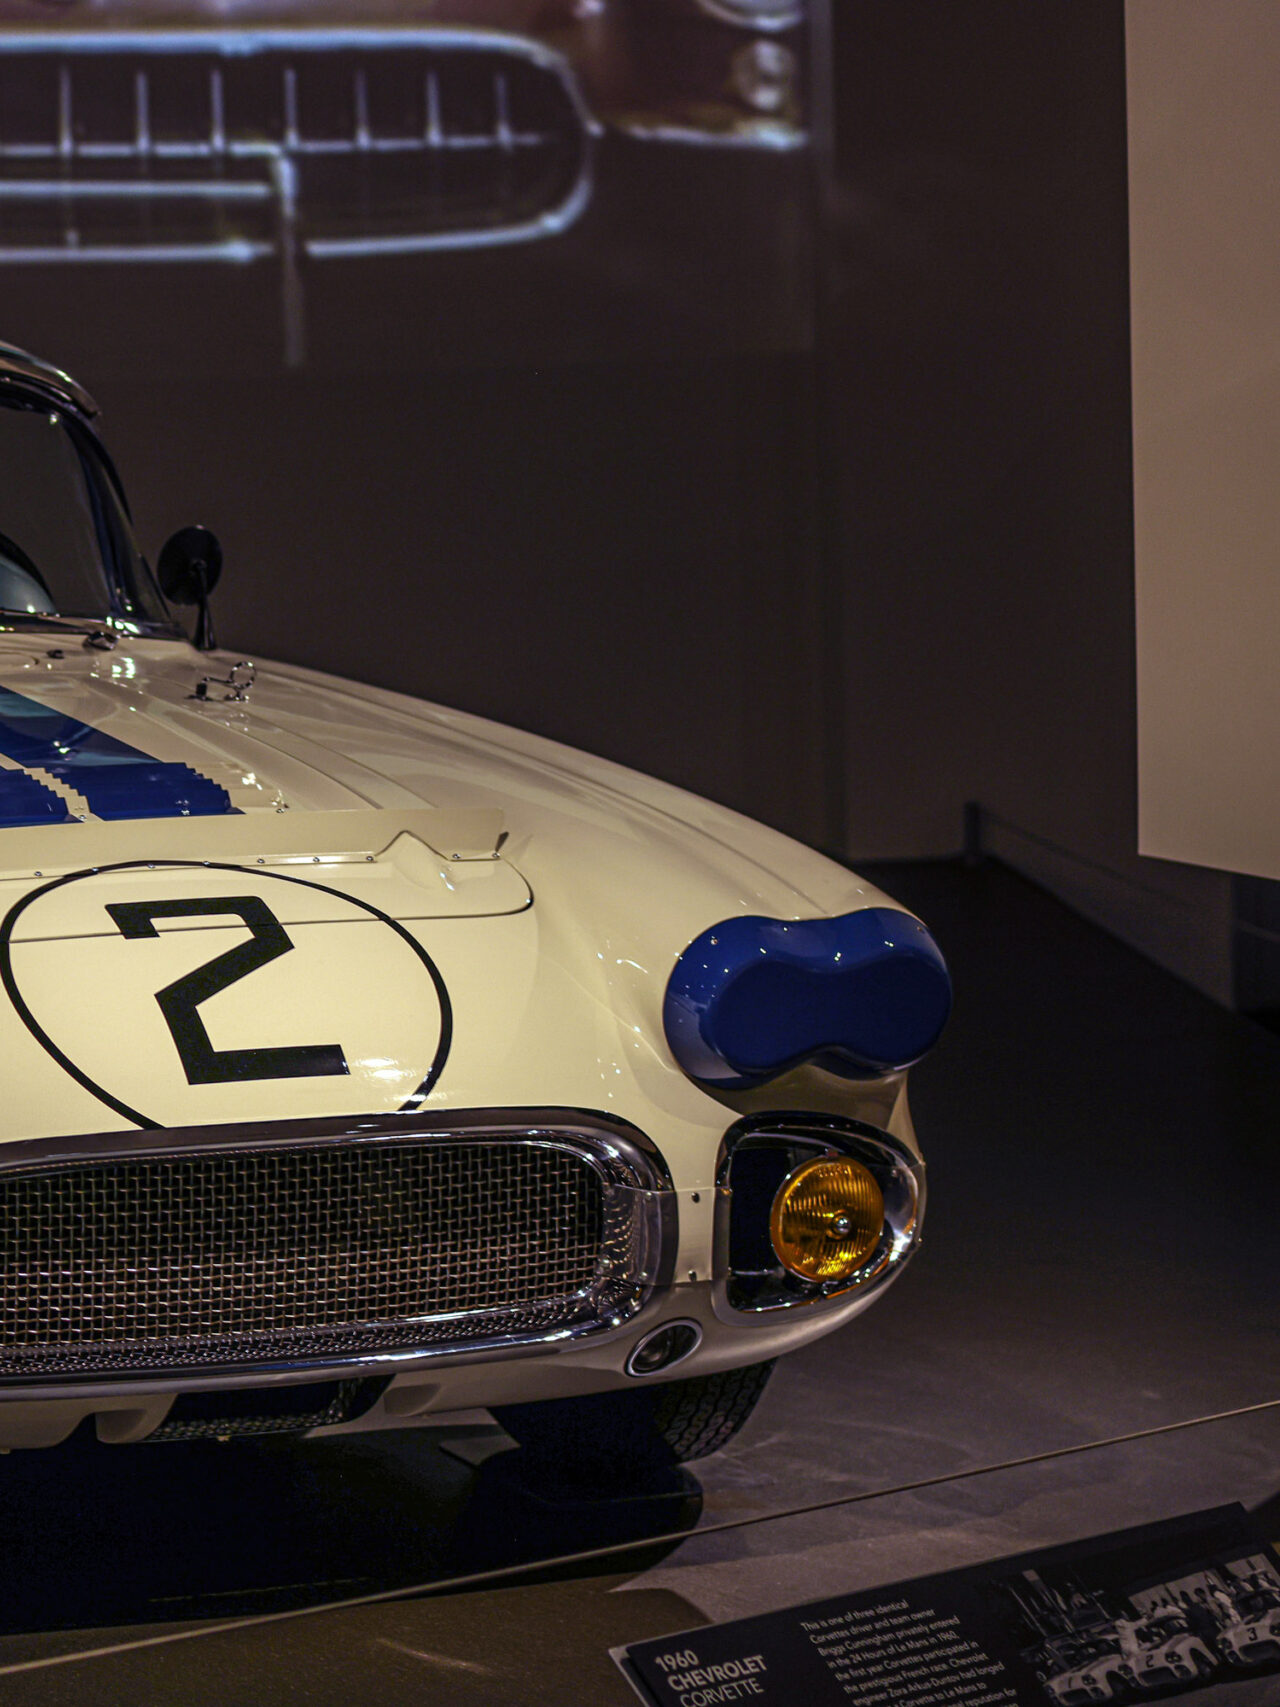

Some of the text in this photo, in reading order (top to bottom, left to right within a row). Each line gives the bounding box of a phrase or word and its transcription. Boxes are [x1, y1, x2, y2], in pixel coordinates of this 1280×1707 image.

[105, 896, 351, 1085] 2
[800, 1622, 820, 1632] This
[827, 1617, 844, 1626] one
[844, 1611, 854, 1622] of
[853, 1610, 875, 1620] three
[874, 1598, 909, 1614] identical
[809, 1609, 935, 1644] Corvettes driver and team owner
[817, 1614, 960, 1657] Briggs Cunningham privately entered
[654, 1649, 700, 1672] 1960
[666, 1654, 768, 1691] CHEVROLET
[826, 1660, 837, 1669] in
[835, 1657, 851, 1667] the
[849, 1653, 862, 1664] 24
[861, 1649, 887, 1660] Hours
[886, 1643, 896, 1655] of
[894, 1643, 907, 1653] Le
[905, 1640, 929, 1650] Mans
[835, 1641, 979, 1681] the first year Corvettes participated in
[679, 1677, 765, 1707] CORVETTE
[843, 1684, 859, 1695] the
[858, 1674, 903, 1692] prestigious
[901, 1666, 930, 1680] French
[948, 1653, 989, 1668] Chevrolet
[852, 1661, 1005, 1707] engineer Zora Arkus-Duntov had longed
[942, 1689, 956, 1698] Le
[953, 1685, 977, 1695] Mans
[976, 1682, 987, 1690] to
